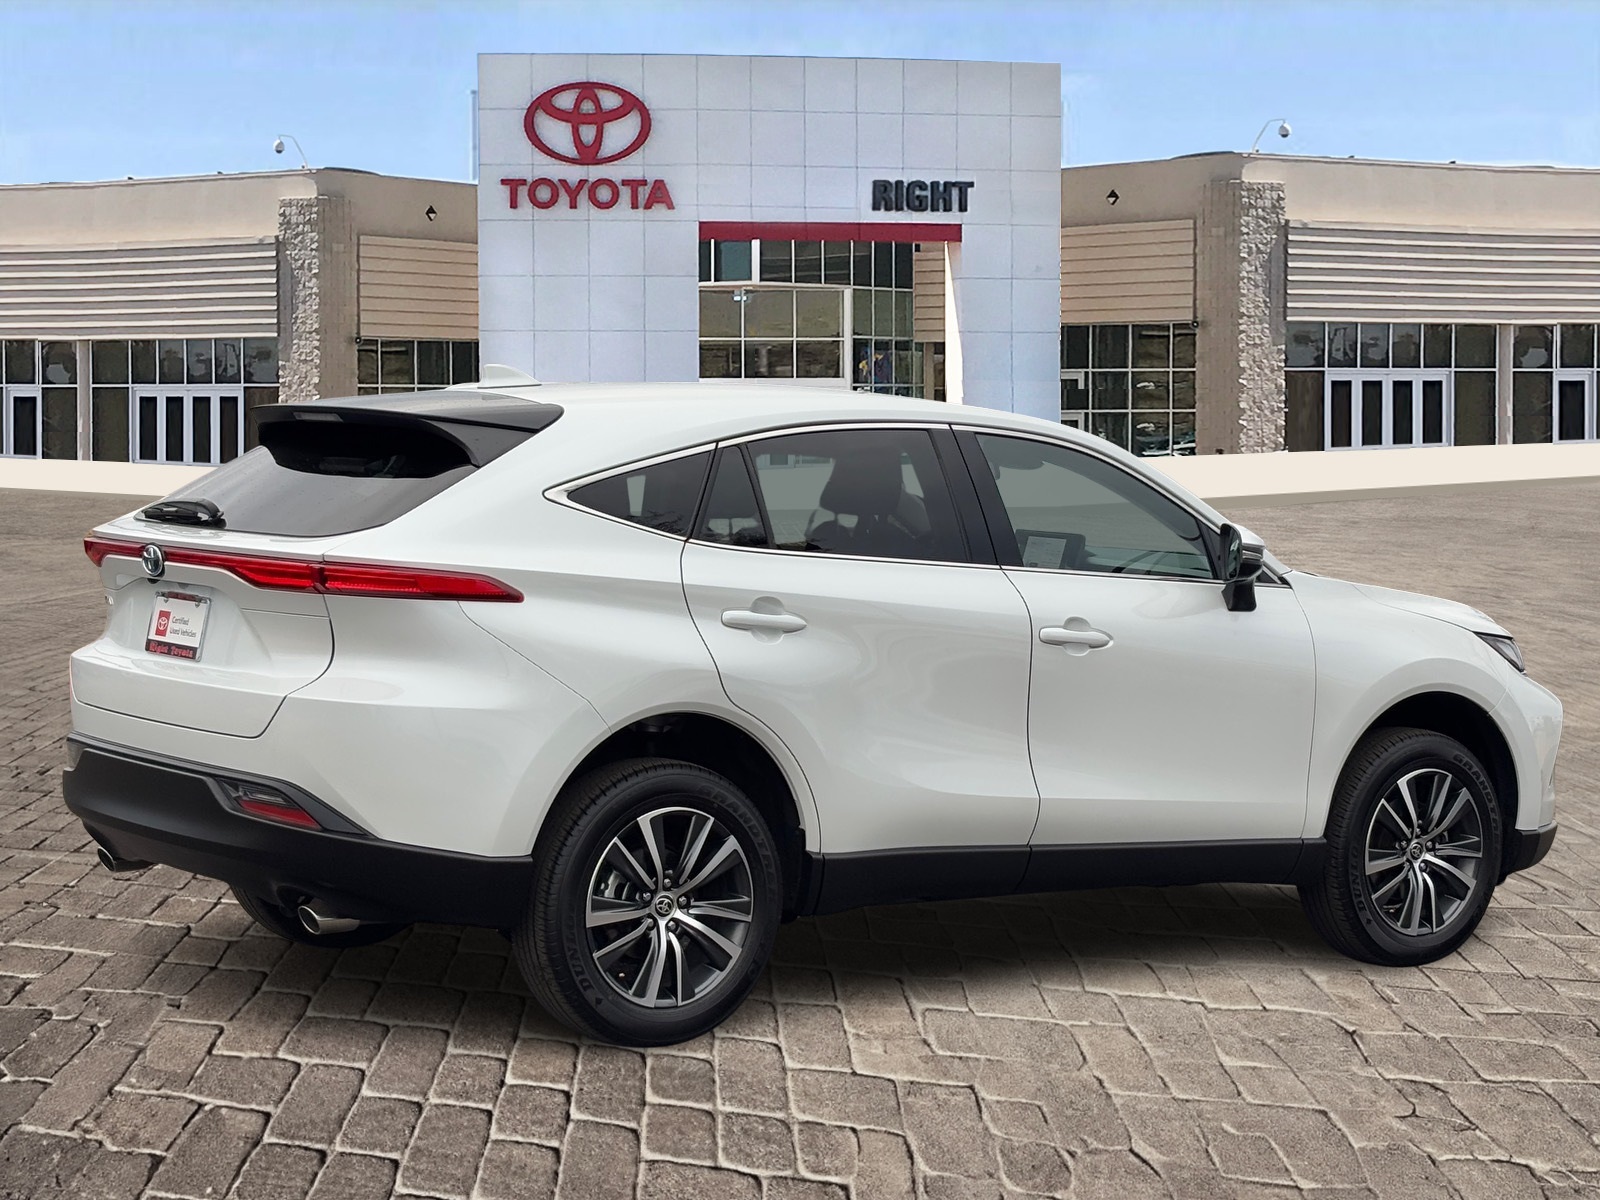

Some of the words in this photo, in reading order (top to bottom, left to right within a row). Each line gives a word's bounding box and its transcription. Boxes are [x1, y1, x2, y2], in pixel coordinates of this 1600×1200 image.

[500, 178, 675, 209] TOYOTA
[872, 179, 975, 212] RIGHT
[172, 616, 190, 626] Certified
[180, 629, 197, 637] Vehicles
[149, 642, 168, 653] Right
[171, 646, 193, 657] Toyota
[1349, 836, 1368, 912] DUNLO
[565, 898, 595, 992] DUNLO
